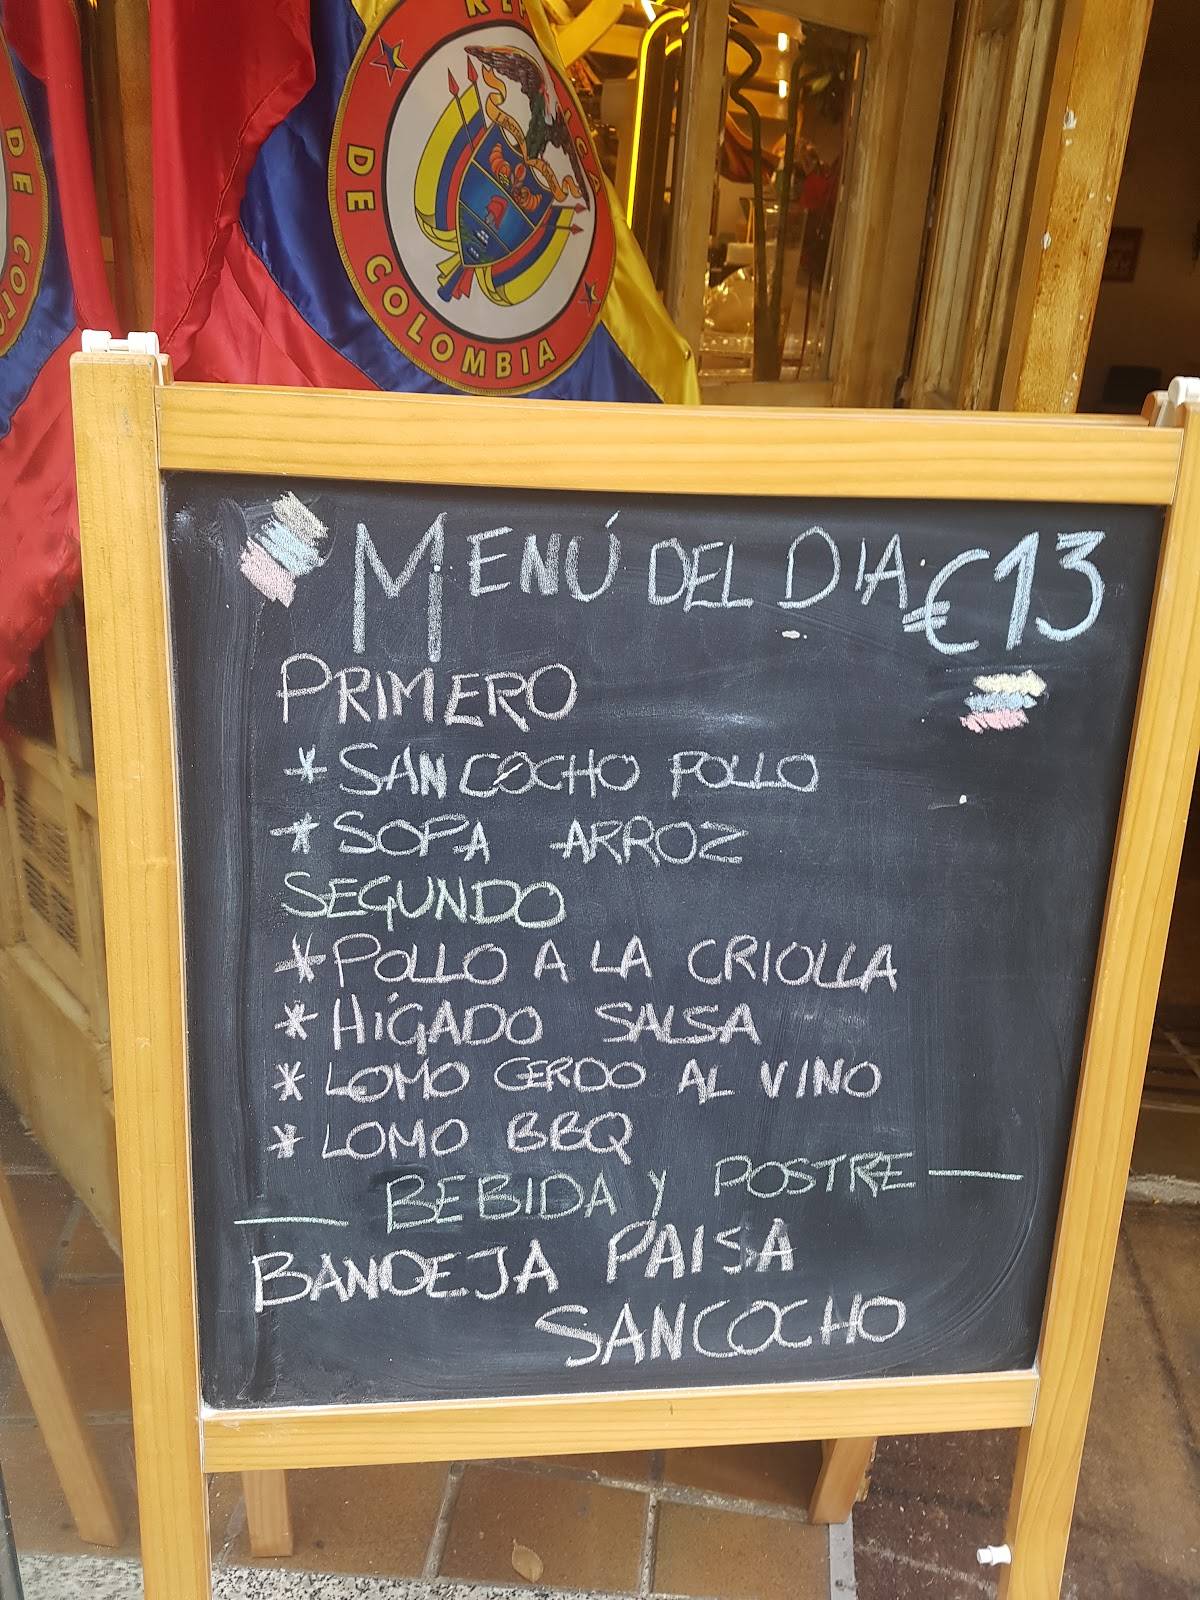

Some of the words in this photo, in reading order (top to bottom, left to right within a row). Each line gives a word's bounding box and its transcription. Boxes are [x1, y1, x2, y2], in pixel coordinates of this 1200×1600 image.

[346, 143, 376, 212] DE
[365, 254, 556, 379] COLOMBIA
[353, 511, 621, 662] MENÚ
[648, 538, 754, 612] DEL
[778, 526, 907, 609] DIA
[277, 652, 577, 732] PRIMERO
[339, 743, 640, 799] SANCOCHO
[669, 751, 819, 799] POLLO
[333, 810, 490, 864] SOPA
[550, 816, 748, 867] ARROZ
[281, 872, 567, 932] SEGUNDO
[333, 933, 507, 987] POLLO
[534, 939, 569, 983] A
[590, 935, 653, 979] LA
[688, 935, 898, 992] CRIOLLA
[594, 1002, 761, 1045] SALSA
[325, 1059, 470, 1103] LOMO
[494, 1056, 646, 1093] CERDO
[677, 1058, 735, 1104] AL
[759, 1056, 881, 1099] VINO
[322, 1118, 469, 1160] LOMO
[507, 1111, 633, 1165] BBQ
[386, 1173, 617, 1234] BEBIDA
[714, 1152, 916, 1198] POSTRE
[251, 1239, 559, 1314] BANDEJA
[607, 1217, 797, 1284] PAISA
[535, 1295, 906, 1367] SANCOCHO
